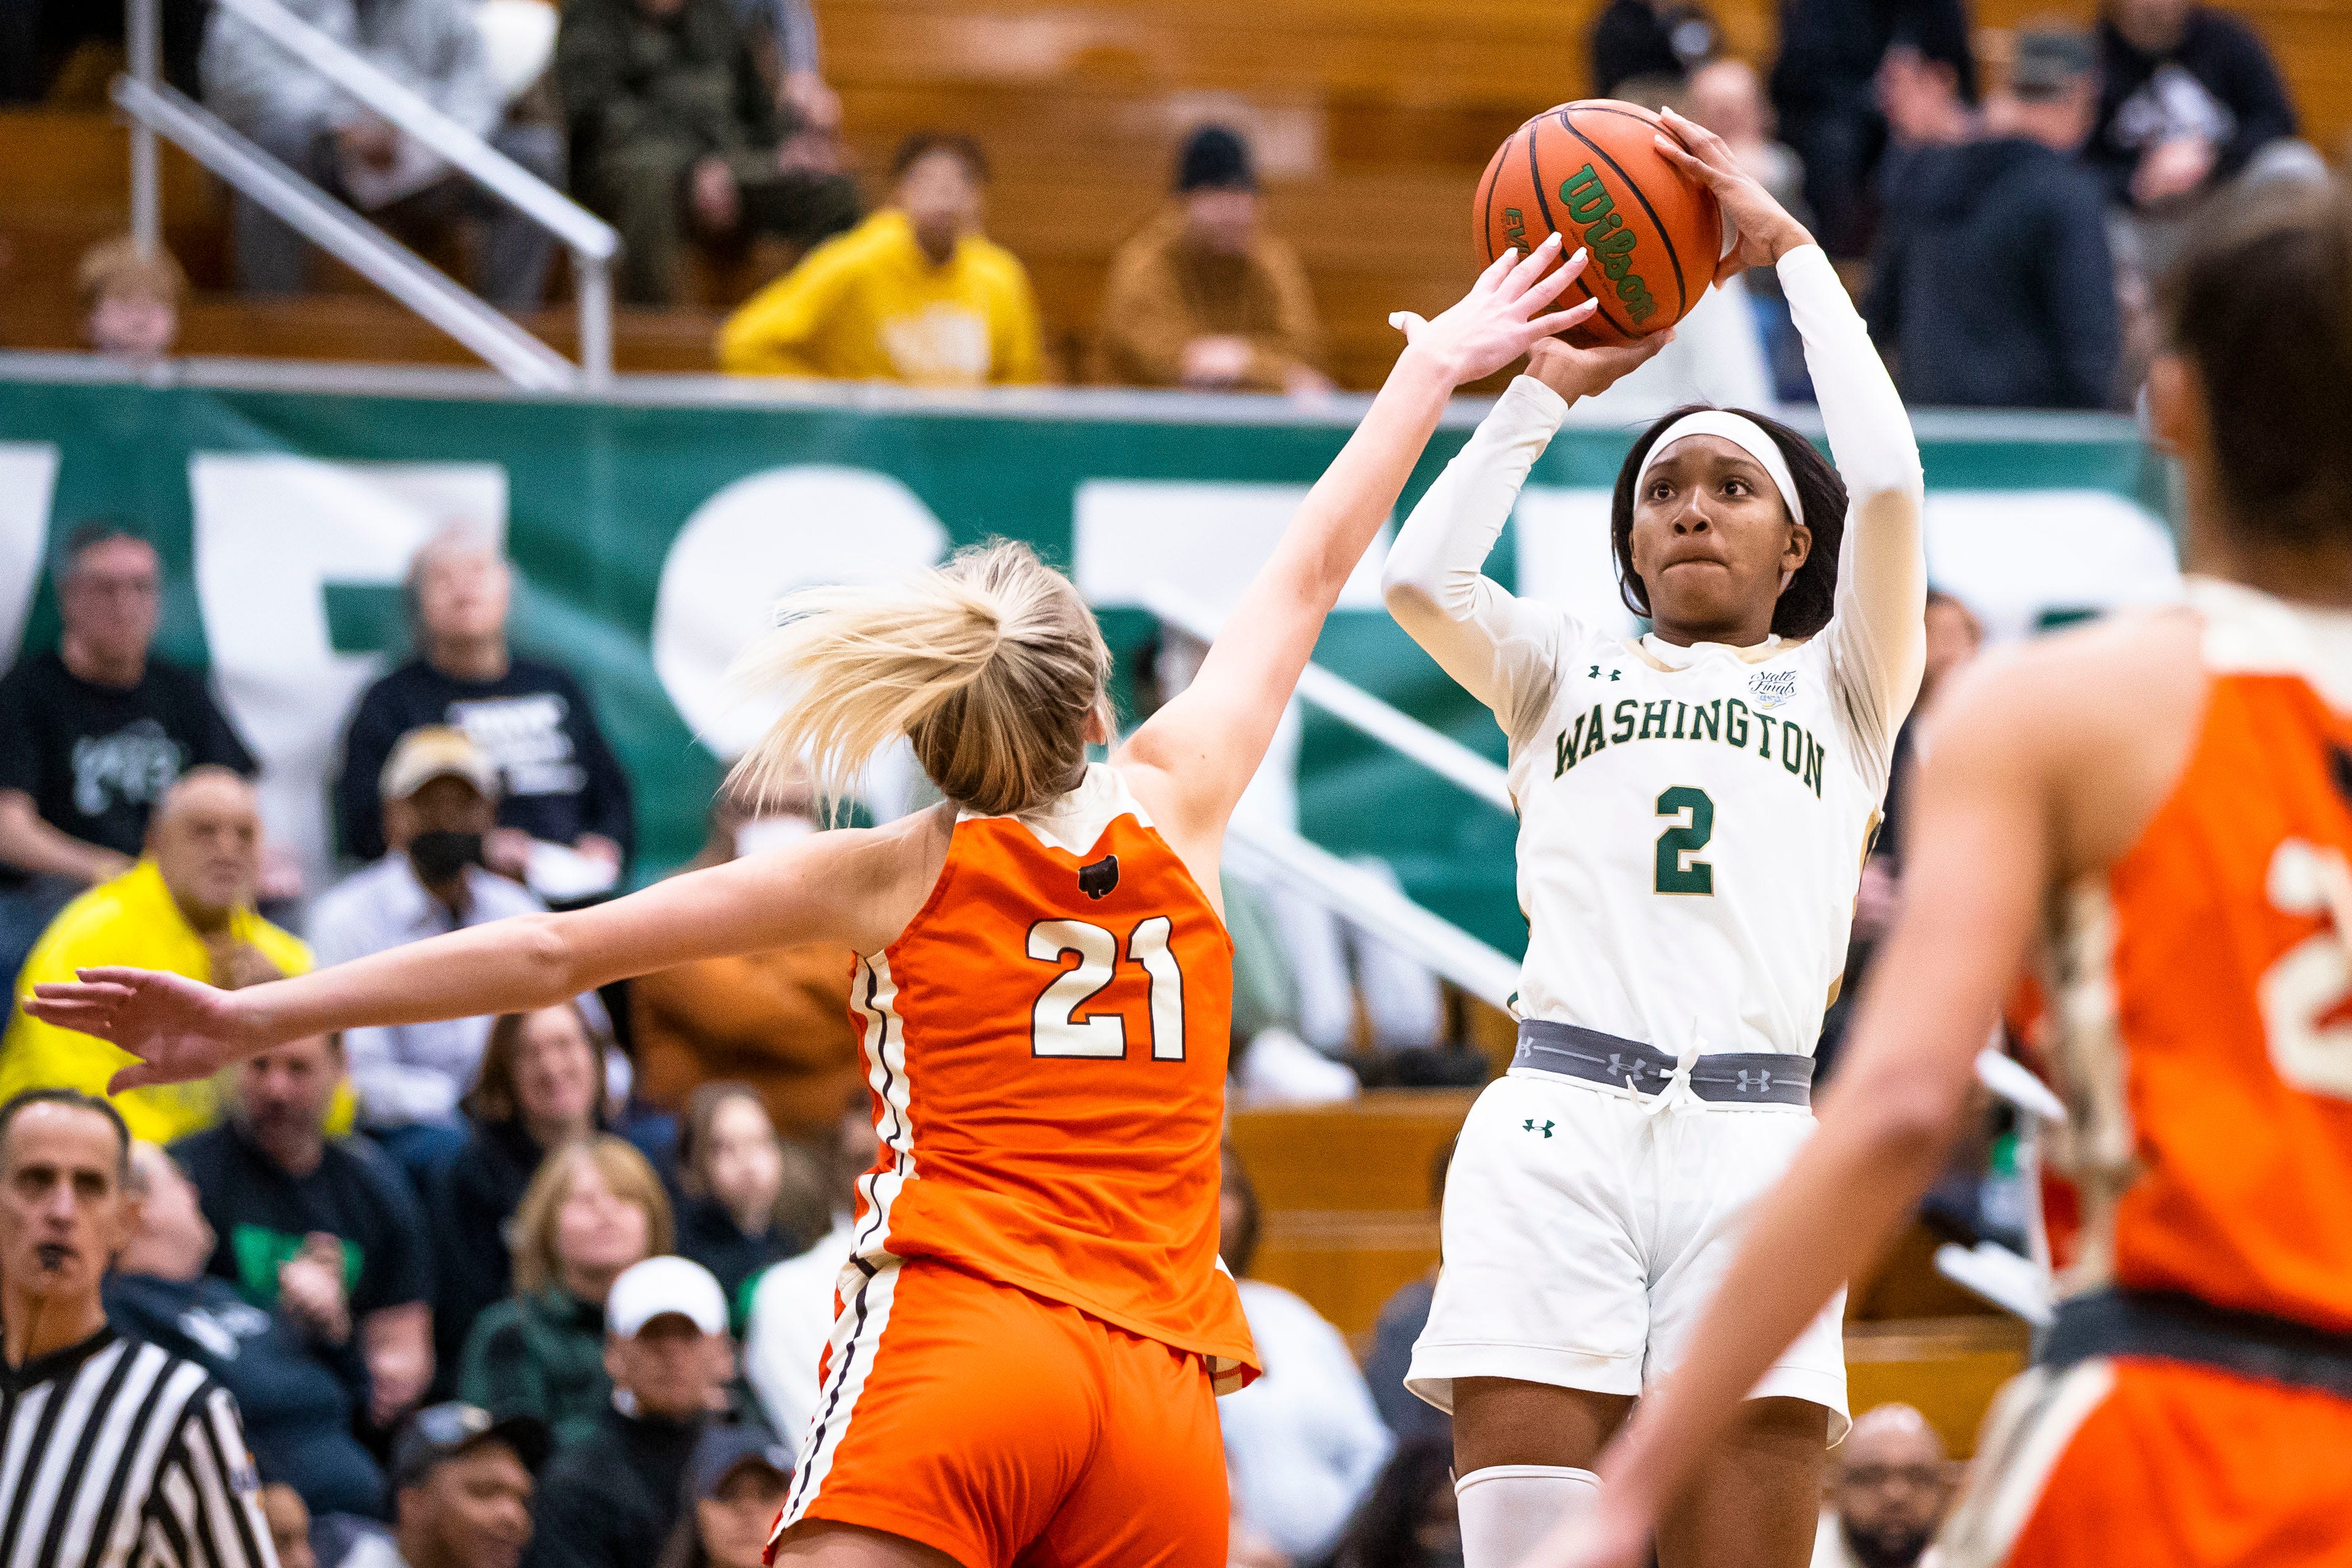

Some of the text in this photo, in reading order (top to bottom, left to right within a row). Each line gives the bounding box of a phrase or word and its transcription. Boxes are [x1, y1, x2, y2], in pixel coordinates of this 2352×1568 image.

[1559, 163, 1656, 325] Wilson
[1748, 680, 1795, 696] Finals
[1751, 670, 1797, 682] State
[1553, 697, 1825, 801] WASHINGTON
[1653, 785, 1716, 897] 2
[1025, 915, 1186, 1063] 21
